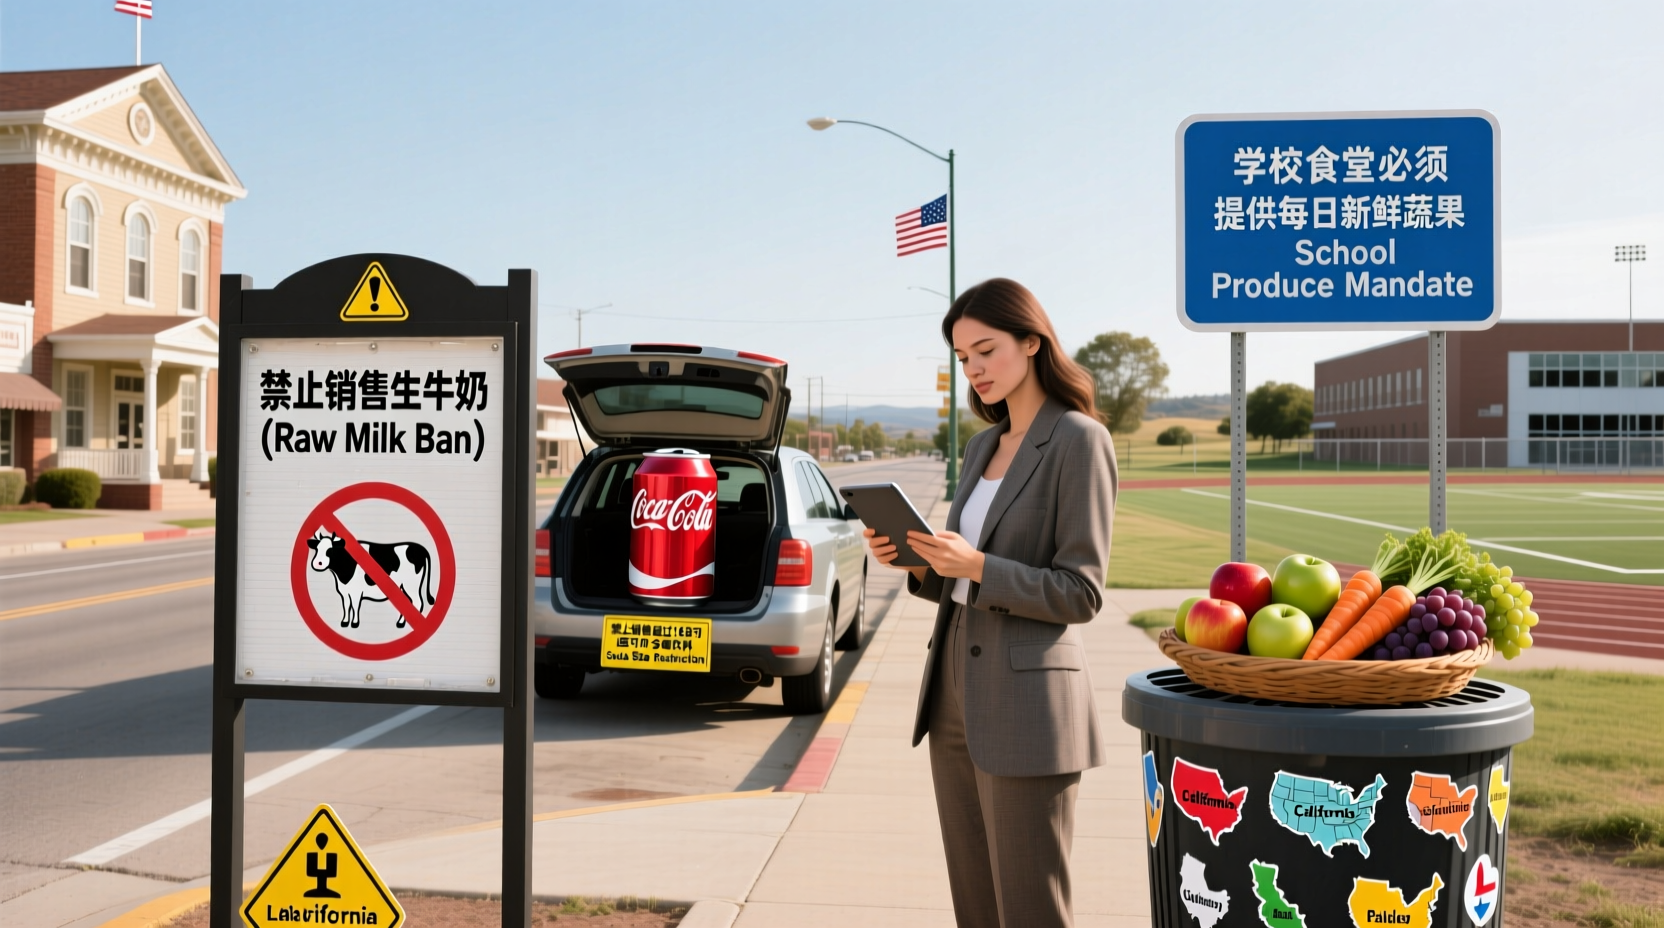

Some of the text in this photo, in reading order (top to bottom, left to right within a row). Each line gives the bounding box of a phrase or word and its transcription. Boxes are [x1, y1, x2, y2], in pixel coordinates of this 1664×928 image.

[1233, 145, 1448, 185] 学校食堂必须
[1214, 194, 1465, 231] 提供每日新鲜蔬果
[1294, 238, 1396, 266] School
[1212, 270, 1473, 299] Produce Mandate
[260, 369, 488, 411] 禁止销售生牛奶
[261, 418, 485, 462] (Raw Milk Ban)
[631, 488, 716, 531] Coca-Cola
